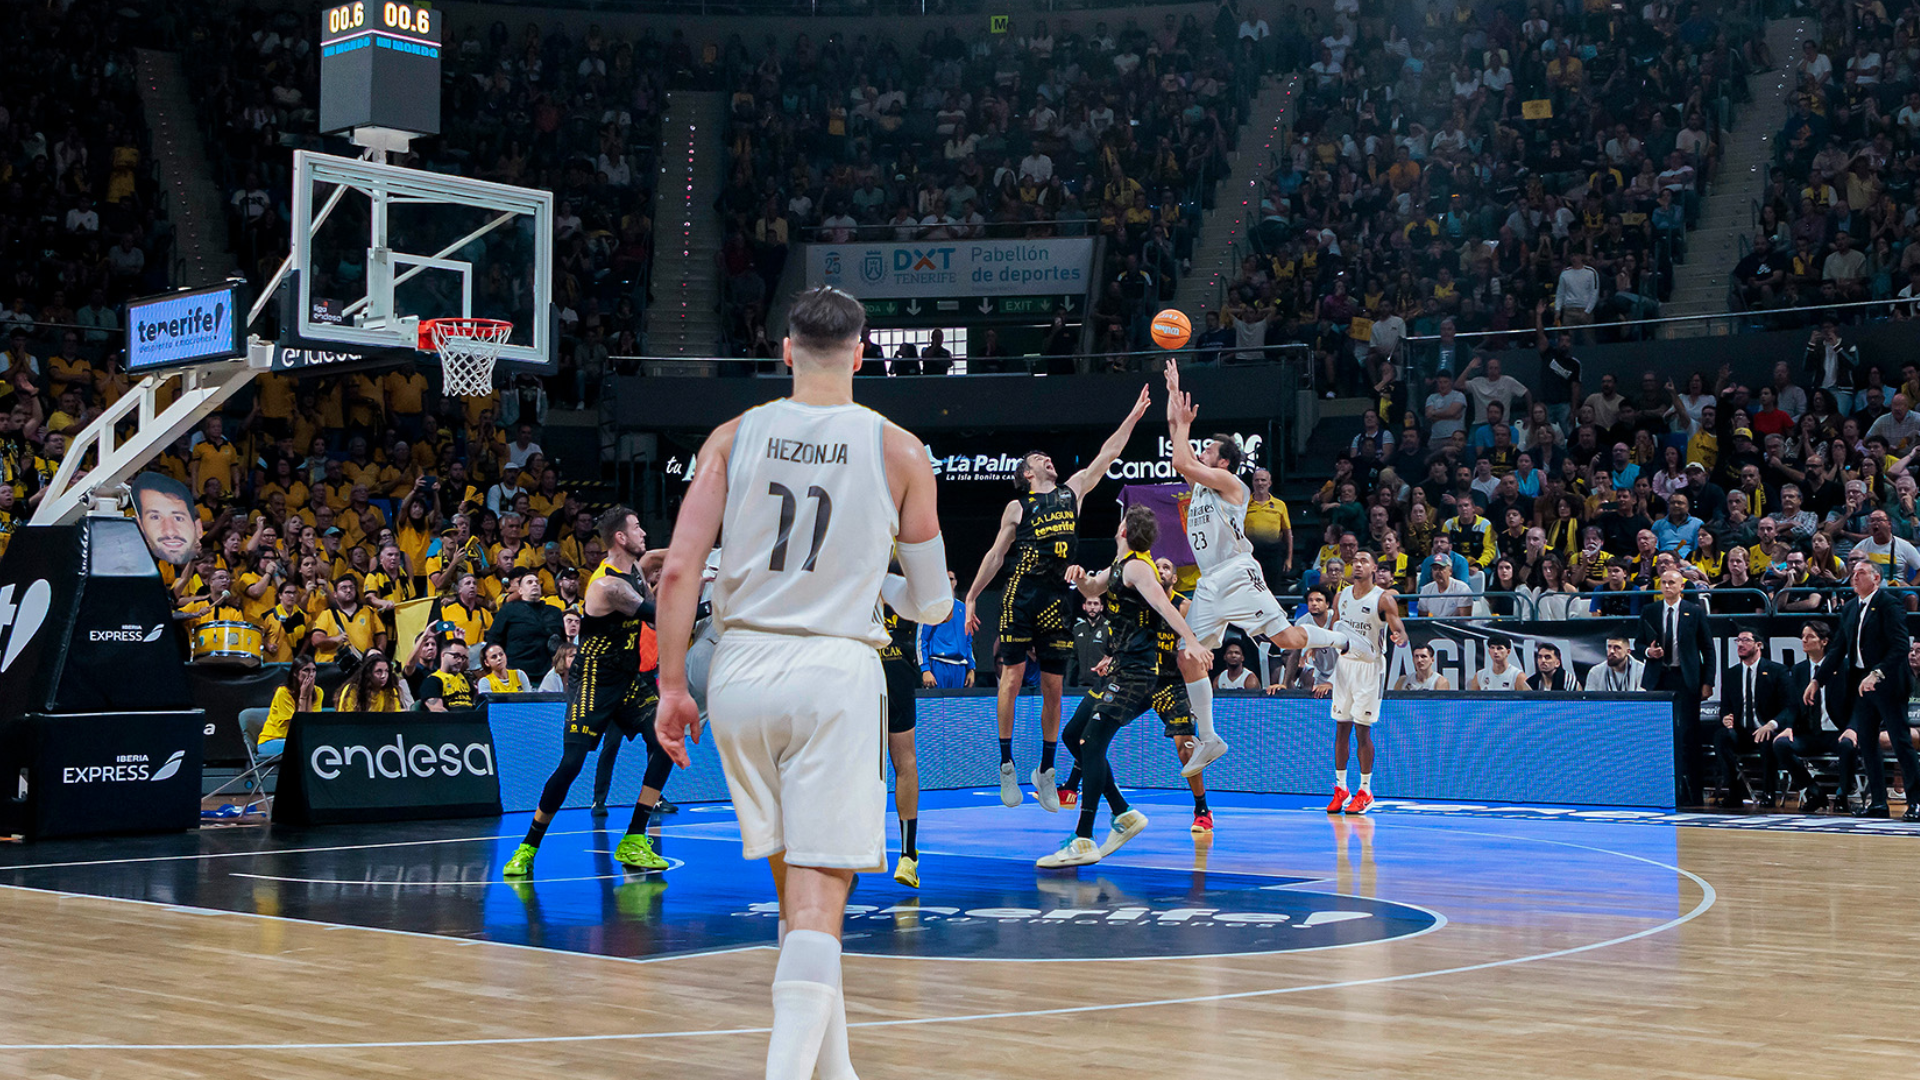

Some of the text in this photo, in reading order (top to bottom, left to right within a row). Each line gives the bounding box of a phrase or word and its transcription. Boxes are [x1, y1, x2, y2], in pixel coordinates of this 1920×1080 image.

[329, 2, 365, 33] 00.6
[384, 1, 430, 34] 00.6
[994, 18, 1006, 30] M
[893, 248, 956, 271] DXT
[971, 246, 1049, 261] Pabellón
[894, 272, 957, 284] TENERIFE
[971, 265, 1080, 284] de deportes
[1005, 300, 1032, 311] EXIT
[138, 302, 224, 343] tenerife!
[766, 437, 848, 464] HEZONJA
[946, 453, 1025, 472] La Palm
[974, 473, 1000, 481] Bonita
[768, 481, 832, 573] 11
[1031, 511, 1074, 527] LA LAGUN
[1192, 531, 1208, 550] 23
[89, 630, 143, 641] EXPRESS
[116, 754, 149, 762] IBERIA
[311, 733, 494, 779] endesa
[63, 765, 150, 783] EXPRESS
